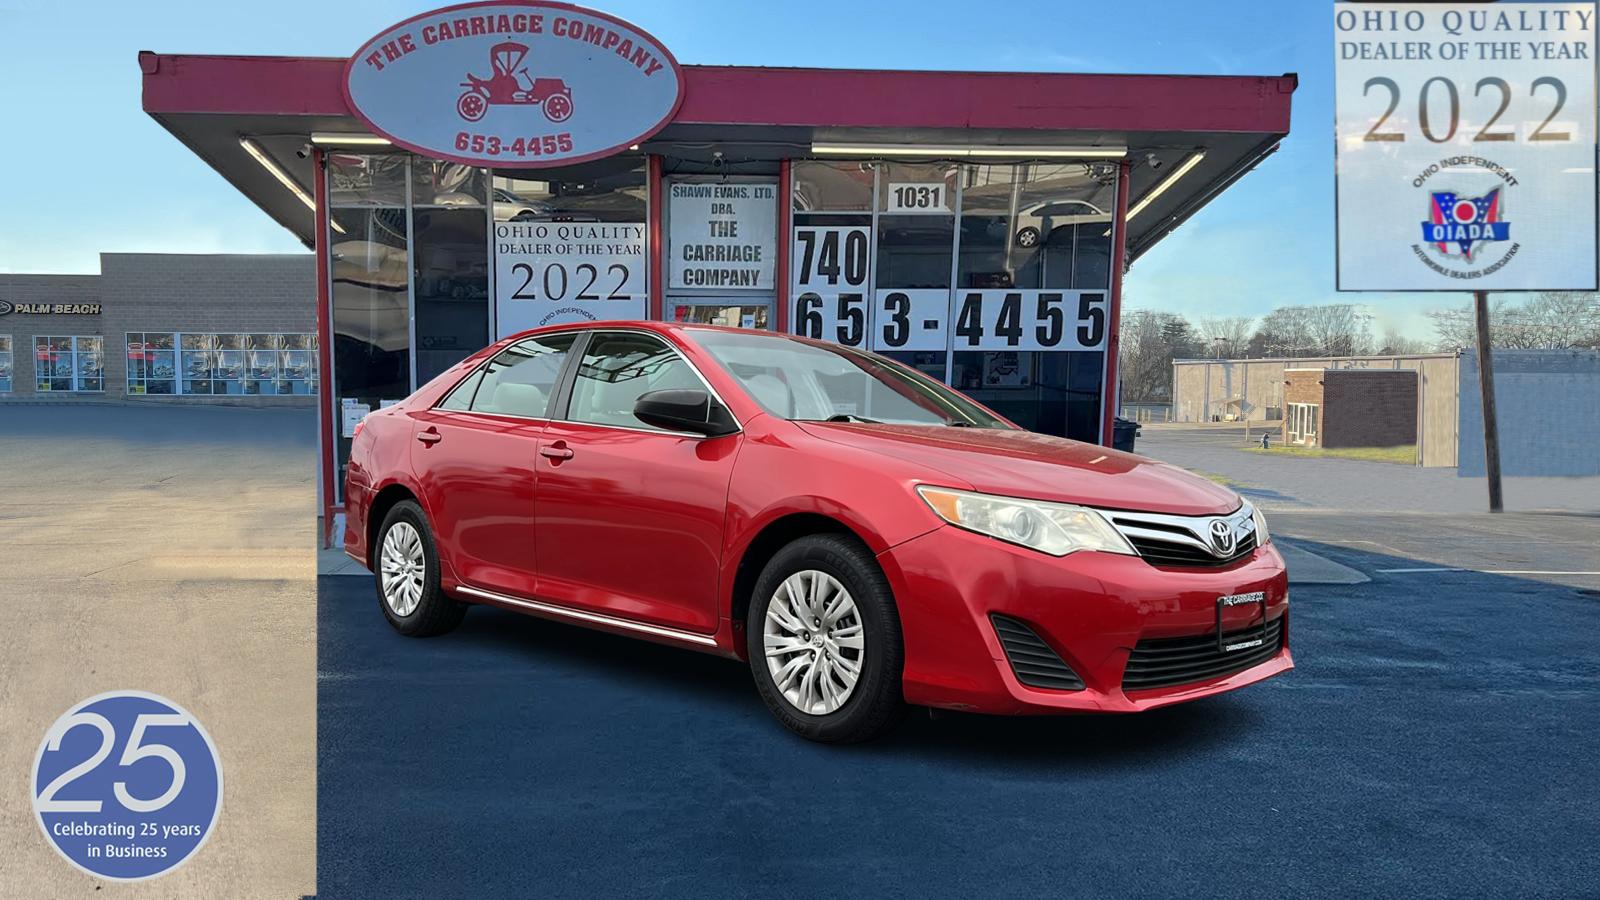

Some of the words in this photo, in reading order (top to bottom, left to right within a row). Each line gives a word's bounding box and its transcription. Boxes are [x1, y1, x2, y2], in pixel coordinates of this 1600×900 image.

[1336, 10, 1425, 31] OHIO
[1442, 10, 1593, 36] QUALITY
[366, 34, 416, 71] THE
[422, 15, 544, 45] CARRIAGE
[553, 17, 664, 77] COMPANY
[1340, 42, 1433, 60] DEALER
[1439, 42, 1469, 60] OF
[1475, 42, 1522, 60] THE
[1528, 41, 1589, 60] YEAR
[1363, 76, 1571, 143] 2022
[455, 132, 573, 156] 653-4455
[1412, 164, 1439, 188] OHIO
[1440, 156, 1519, 187] INDEPENDENT
[672, 185, 712, 199] SHAWN
[713, 185, 750, 199] EVANS.
[754, 185, 775, 199] LTD.
[894, 187, 940, 208] 1031
[711, 203, 736, 215] DBA.
[497, 226, 548, 239] OHIO
[557, 226, 644, 241] QUALITY
[708, 220, 738, 238] THE
[1432, 224, 1496, 240] OIADA
[500, 243, 552, 255] DEALER
[555, 243, 573, 255] OF
[576, 243, 603, 255] THE
[606, 243, 641, 255] YEAR
[683, 244, 762, 263] CARRIAGE
[797, 230, 868, 285] 740
[511, 262, 632, 301] 2022
[683, 268, 761, 286] COMPANY
[1449, 270, 1482, 279] DEALERS
[15, 303, 51, 314] PALM
